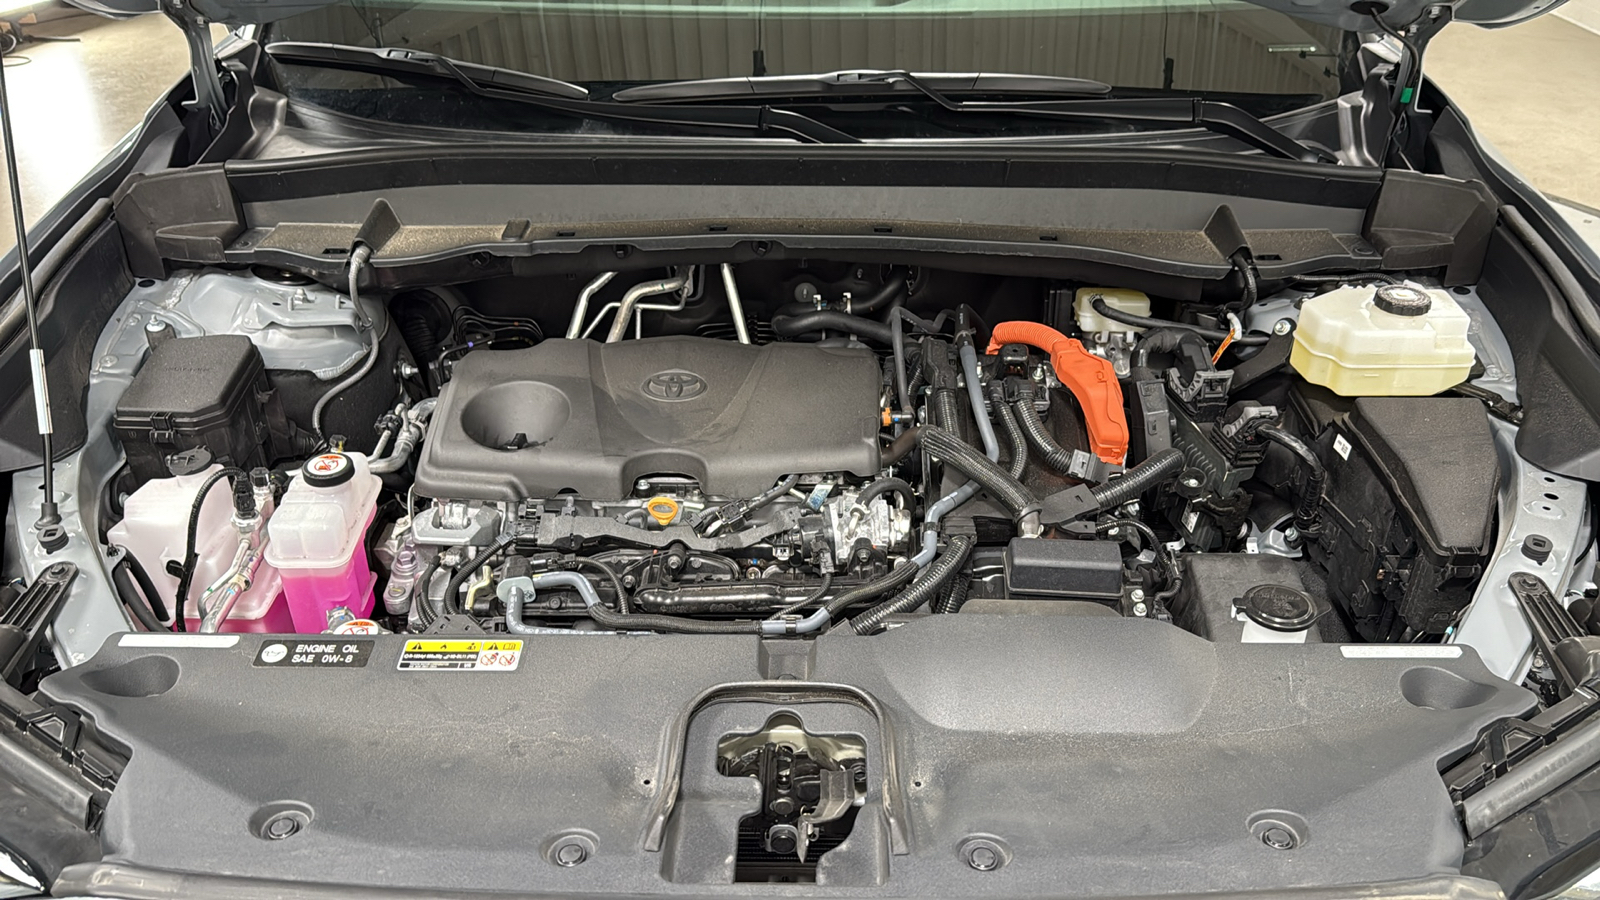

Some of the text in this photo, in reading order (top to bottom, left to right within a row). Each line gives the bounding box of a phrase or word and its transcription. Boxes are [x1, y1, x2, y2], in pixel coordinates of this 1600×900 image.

[295, 644, 359, 653] ENGINE OIL
[291, 654, 353, 663] SAE 0W-8
